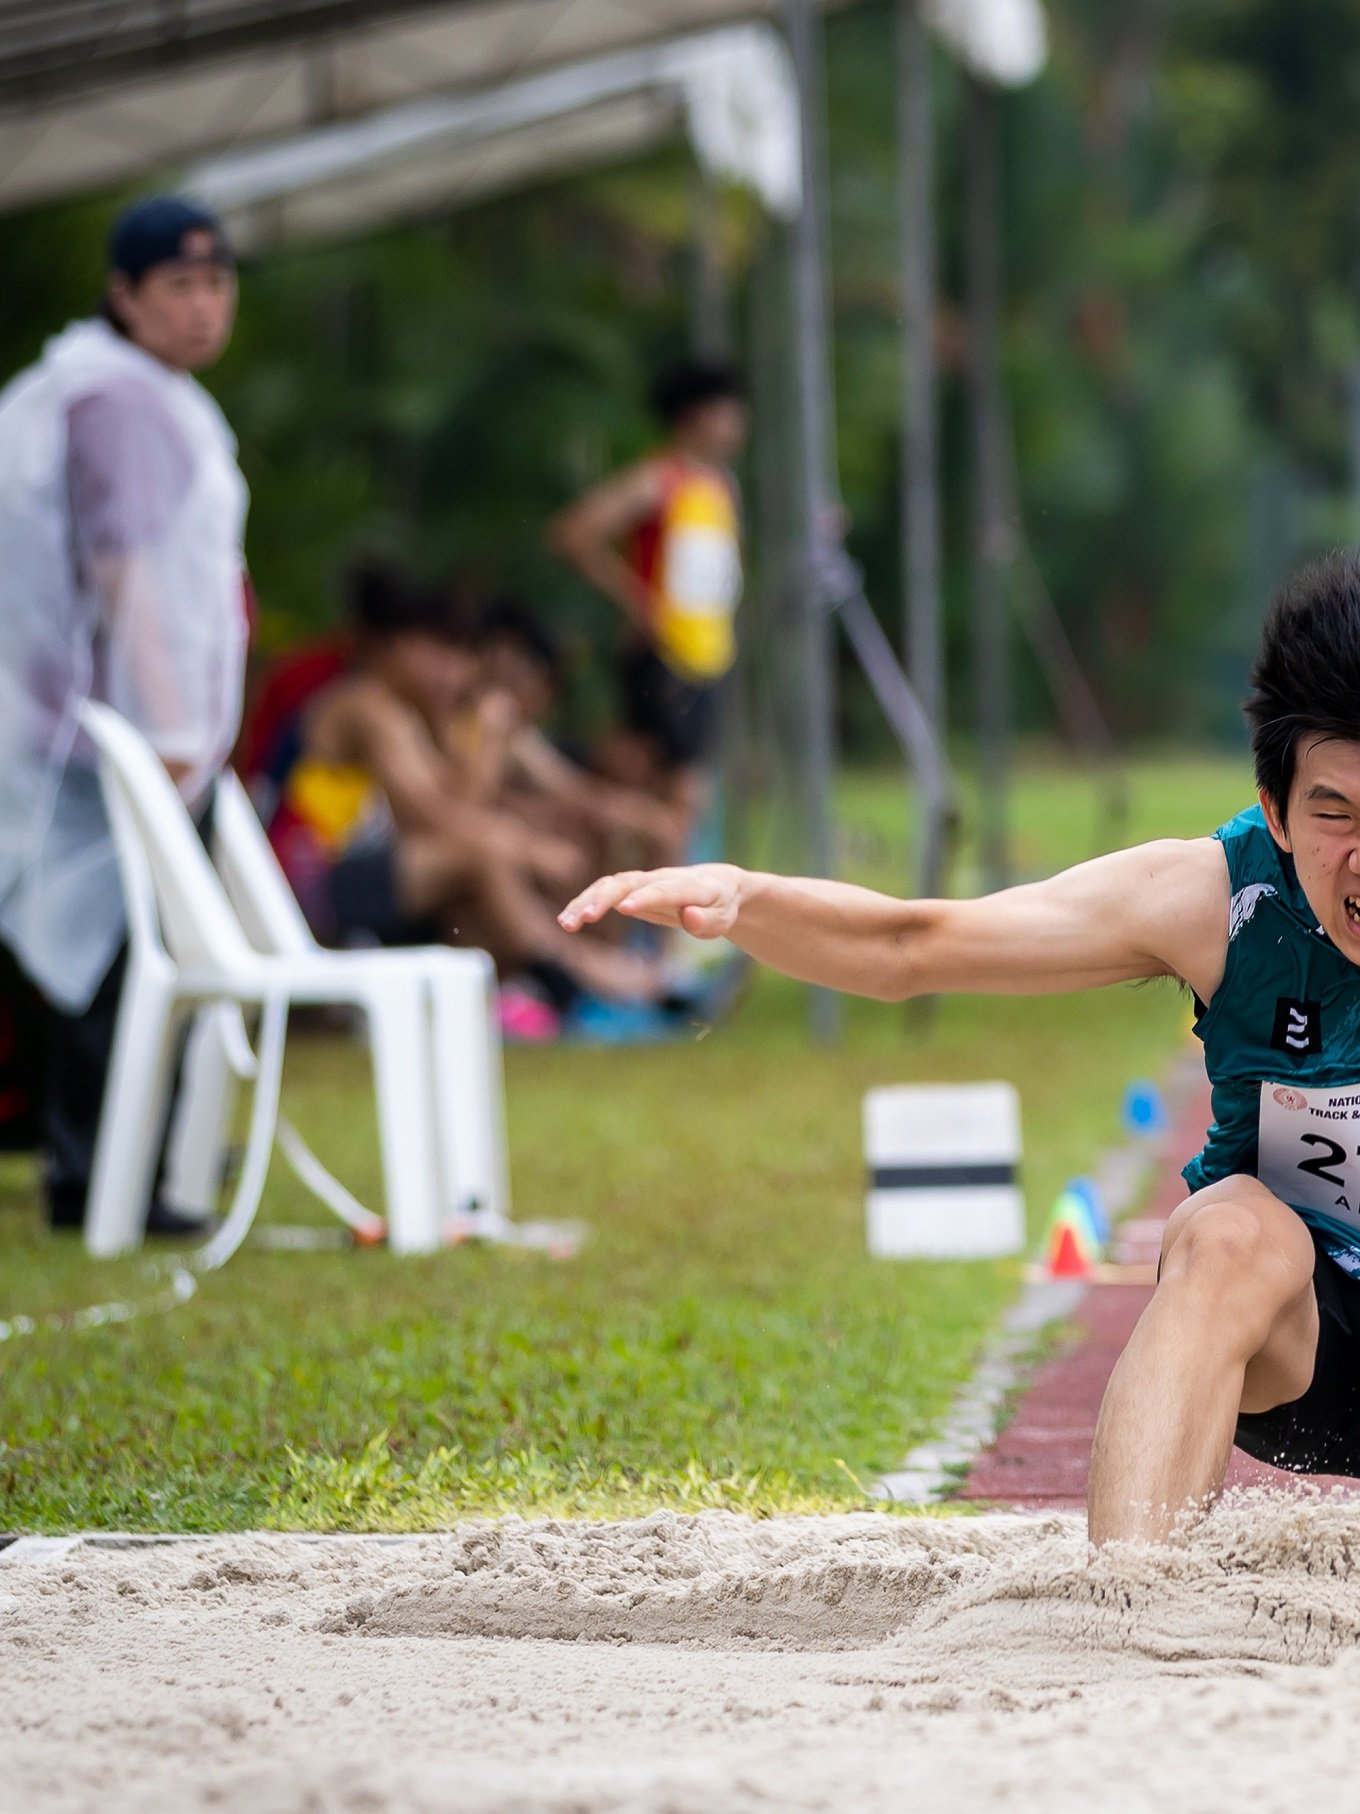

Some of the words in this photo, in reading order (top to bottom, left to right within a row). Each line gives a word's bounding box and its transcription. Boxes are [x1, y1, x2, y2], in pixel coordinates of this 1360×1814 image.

[1309, 1107, 1348, 1120] TRACK
[1352, 1110, 1360, 1119] &
[1334, 1195, 1351, 1211] A
